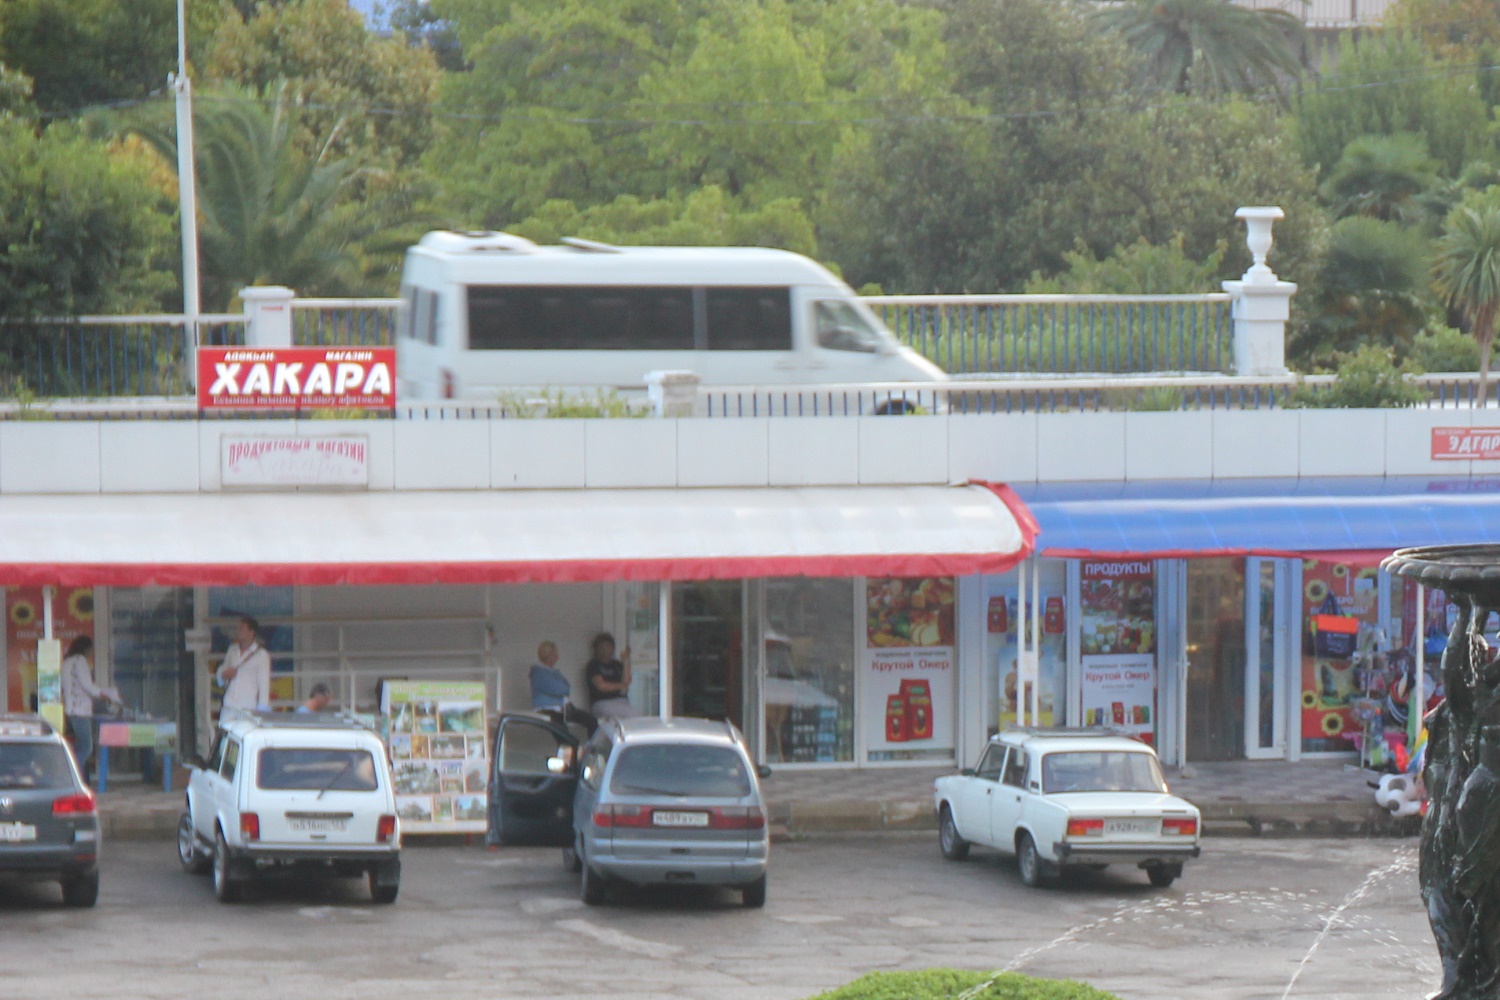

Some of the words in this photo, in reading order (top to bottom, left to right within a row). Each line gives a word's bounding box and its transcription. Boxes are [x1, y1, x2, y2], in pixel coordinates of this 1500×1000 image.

[325, 350, 374, 362] МАГАЗИН
[208, 362, 392, 395] ХАКАРА
[315, 439, 365, 465] МАГАЗИН
[1085, 561, 1151, 576] ПРОДУКТЫ
[871, 660, 914, 672] Крутой
[918, 659, 949, 671] Окер
[1085, 671, 1122, 682] Крутой
